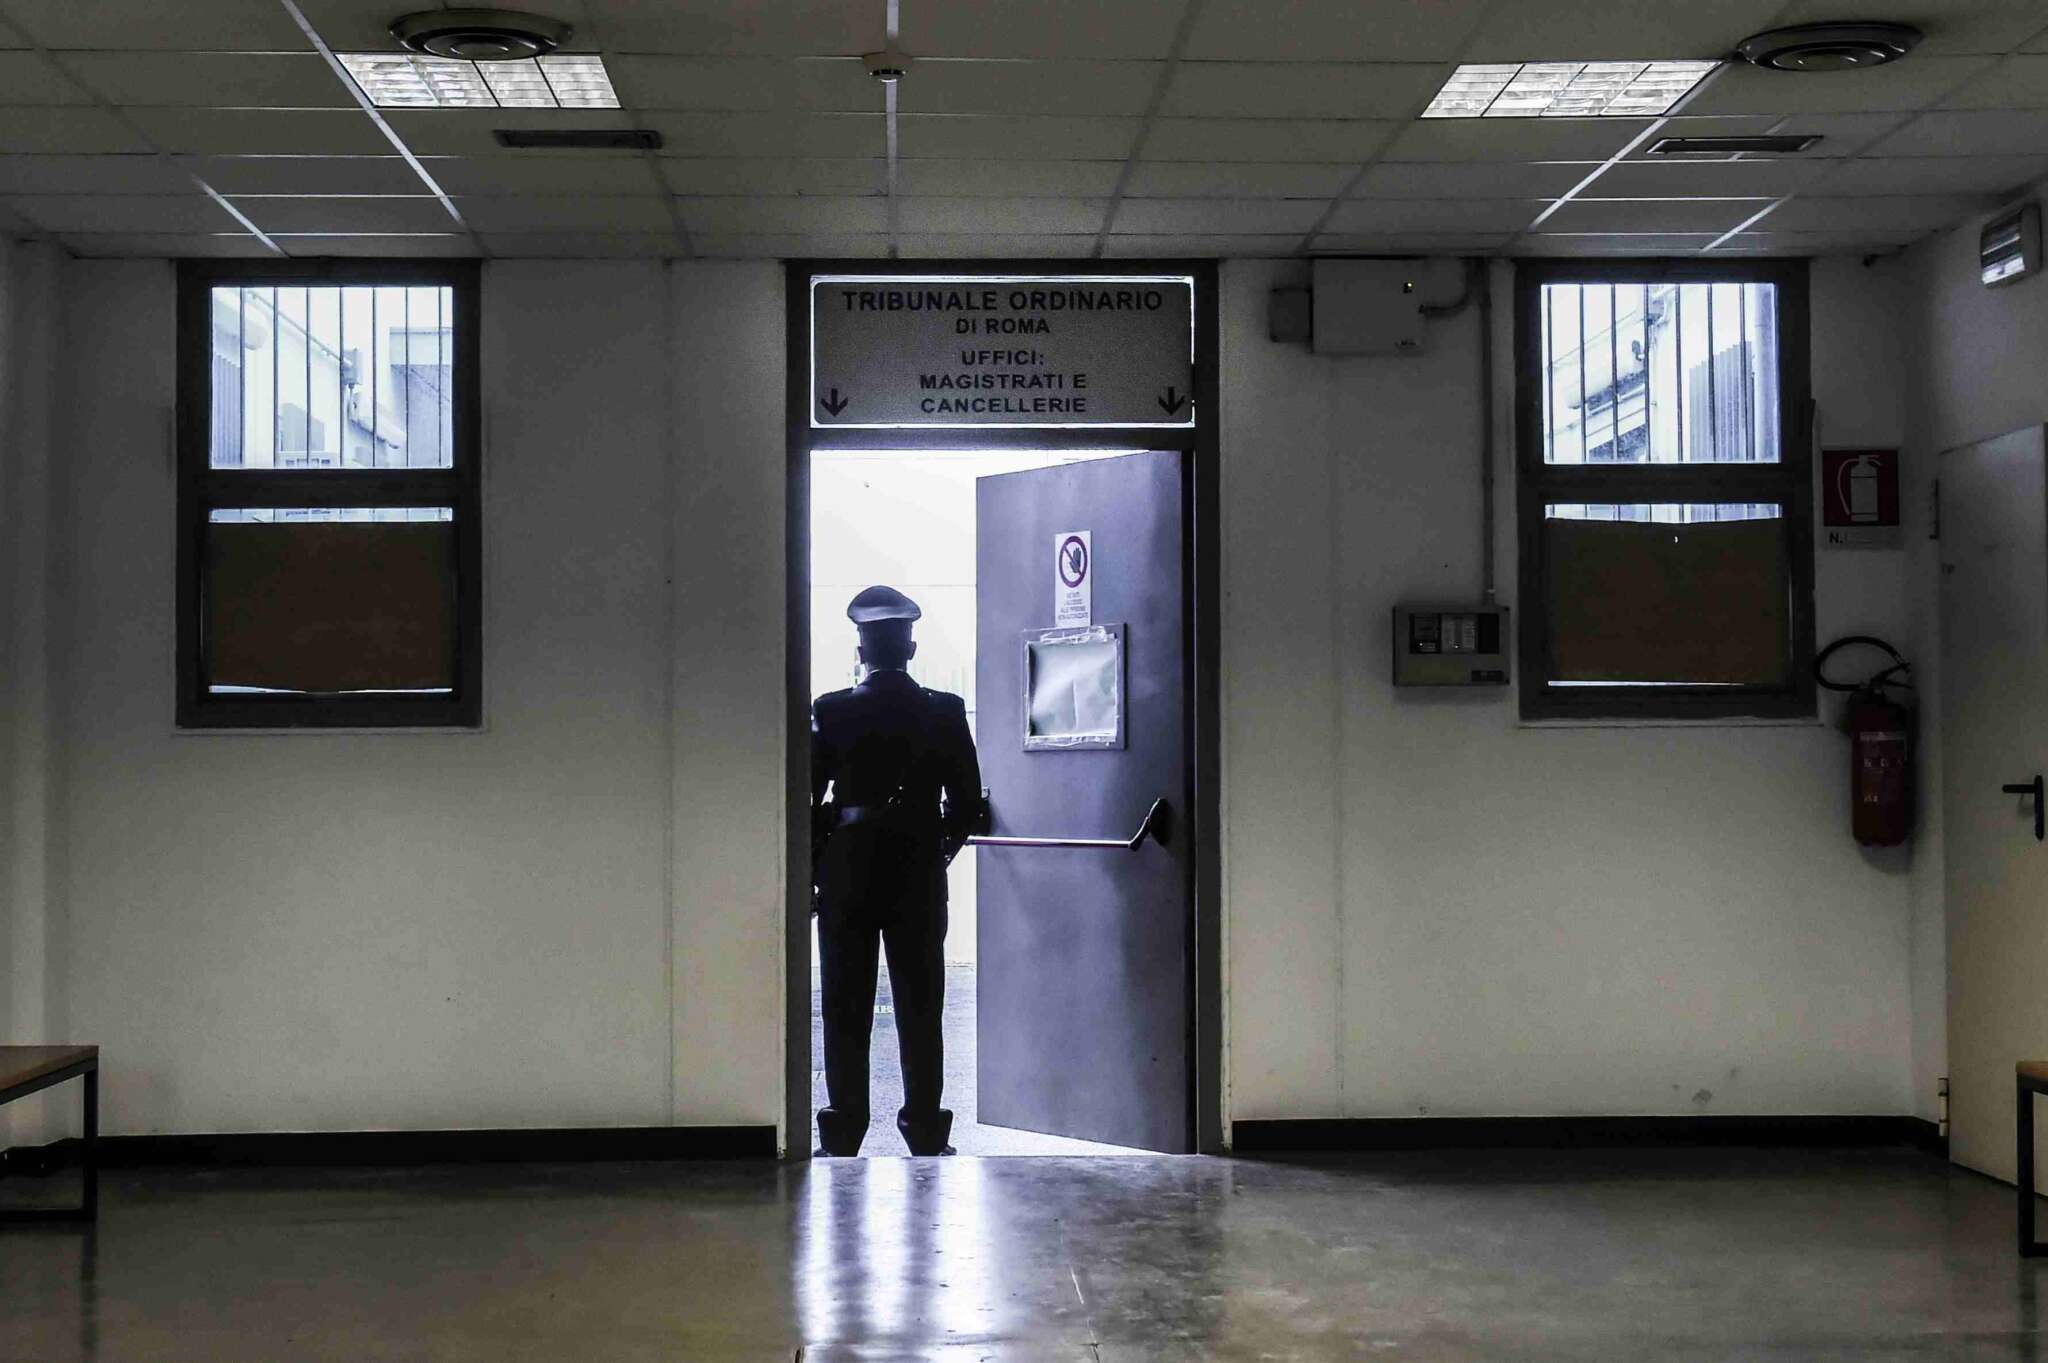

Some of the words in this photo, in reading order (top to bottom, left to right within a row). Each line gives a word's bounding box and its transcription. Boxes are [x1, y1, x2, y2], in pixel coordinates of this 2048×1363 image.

[842, 291, 997, 311] TRIBUNALE
[1009, 290, 1163, 311] ORDINARIO
[955, 318, 977, 334] DI
[986, 317, 1050, 334] ROMA
[961, 349, 1045, 366] UFFICI:
[919, 374, 1064, 390] MAGISTRATI
[1073, 374, 1087, 389] E
[920, 397, 1087, 413] CANCELLERIE
